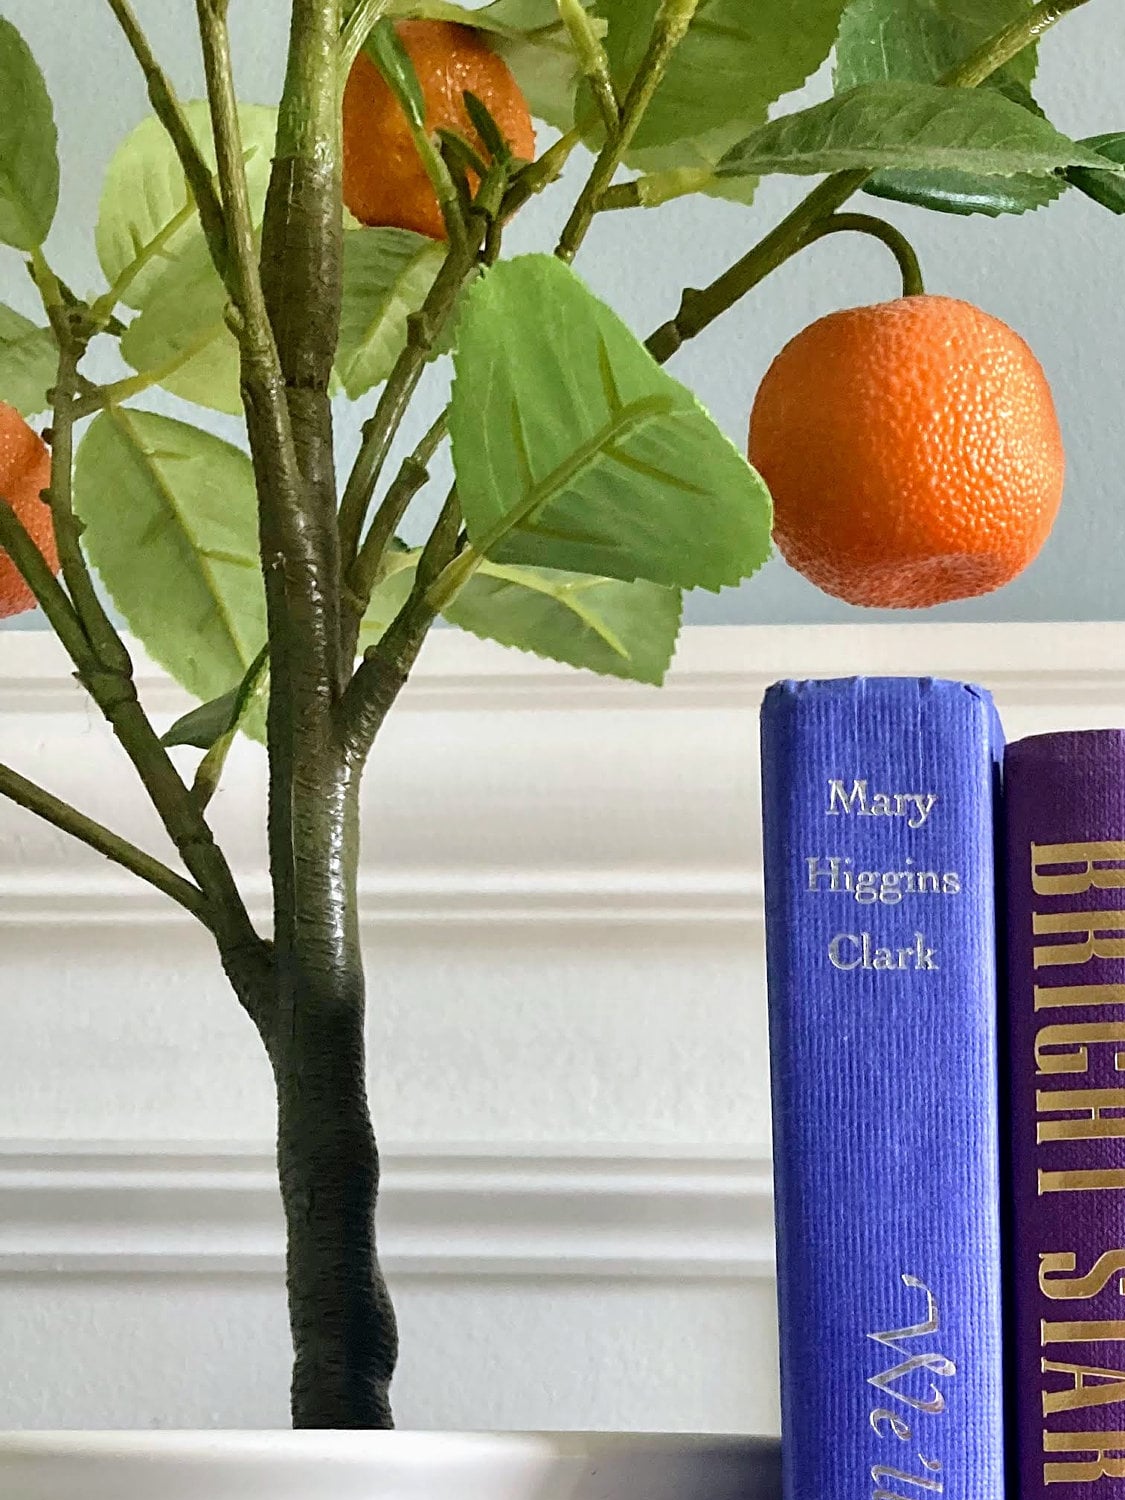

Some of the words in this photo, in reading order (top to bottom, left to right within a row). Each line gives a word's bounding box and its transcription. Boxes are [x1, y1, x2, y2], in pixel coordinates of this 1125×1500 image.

[826, 779, 937, 830] Mary
[805, 856, 961, 905] Higgins
[828, 933, 939, 973] Clark
